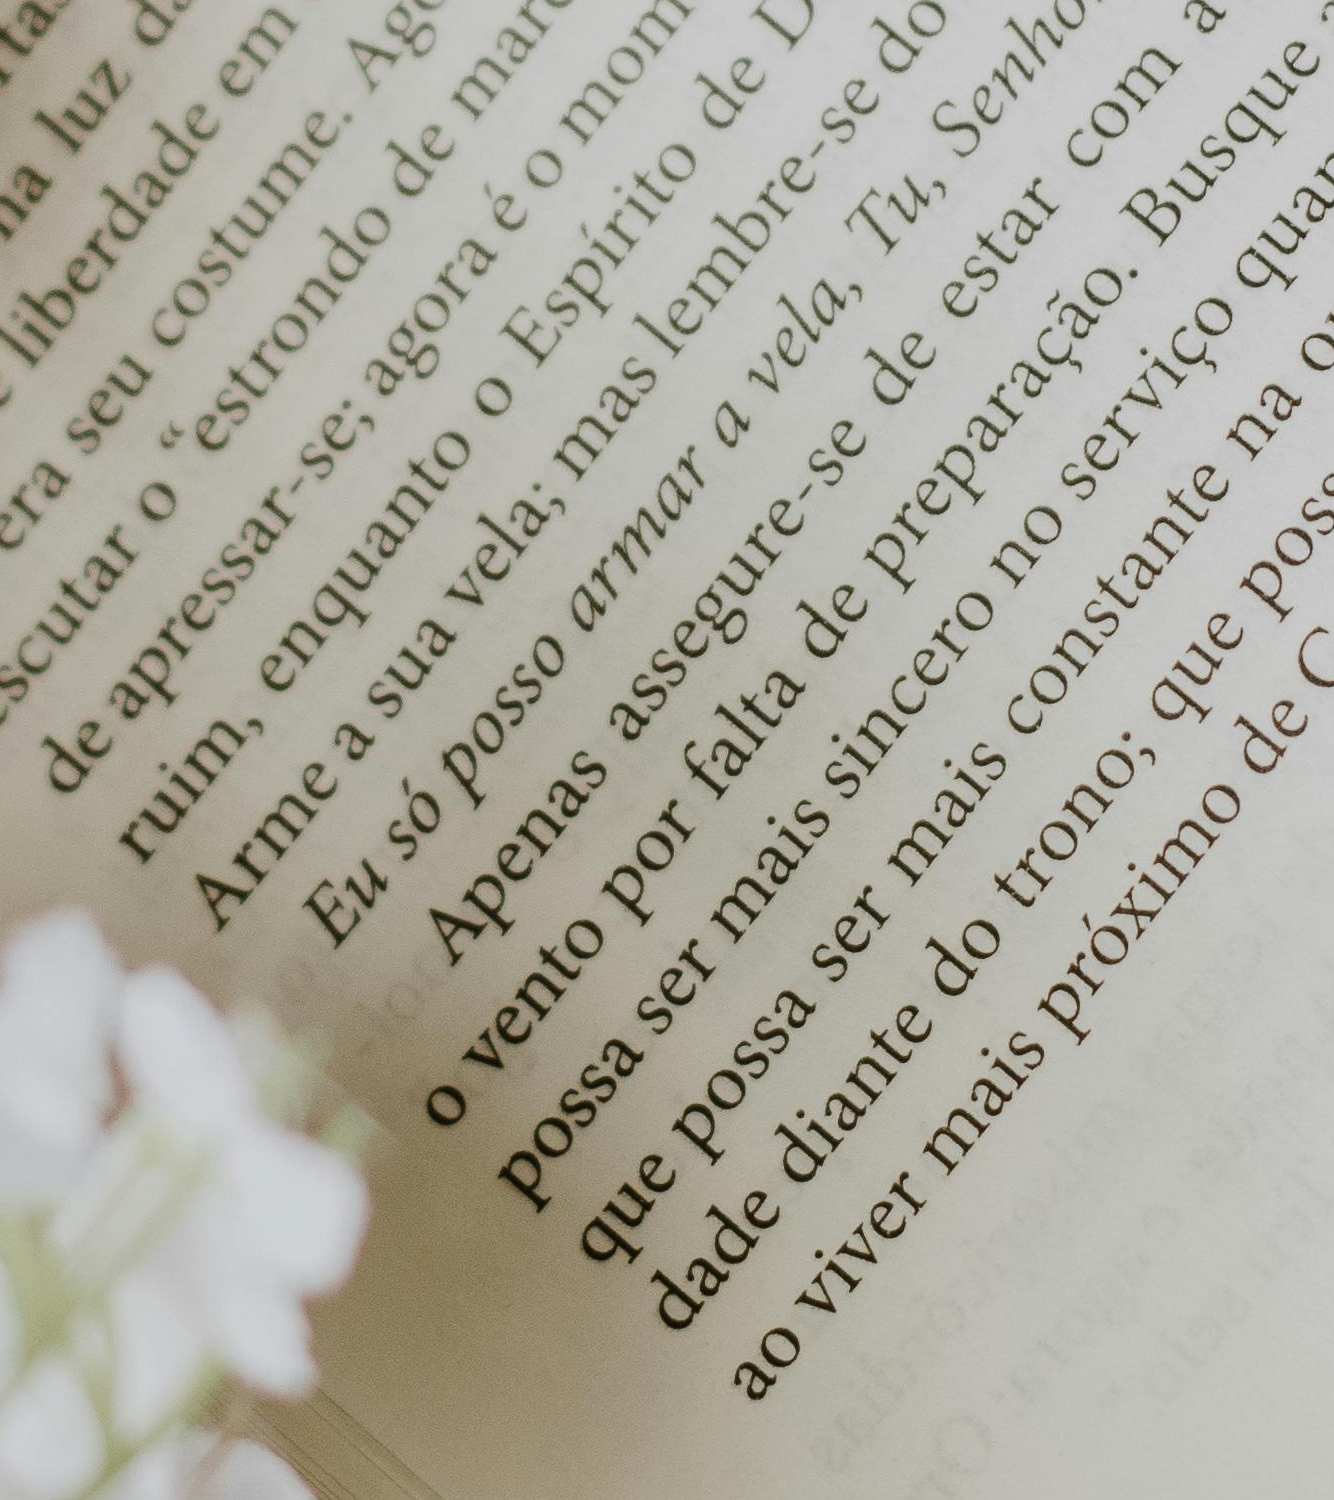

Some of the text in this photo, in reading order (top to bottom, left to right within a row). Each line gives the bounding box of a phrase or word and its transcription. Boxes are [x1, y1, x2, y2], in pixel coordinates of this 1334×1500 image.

[136, 480, 178, 524] o
[158, 205, 392, 454] “estrondo
[384, 123, 455, 199] de
[217, 5, 300, 99] em
[40, 719, 114, 795] de
[106, 398, 375, 721] apressar-se;
[363, 237, 499, 398] agora
[482, 181, 529, 233] é
[523, 147, 564, 190] o
[117, 717, 264, 866] ruim,
[259, 430, 471, 693] enquanto
[472, 375, 513, 418] o
[498, 142, 697, 369] Espírito
[693, 55, 766, 131] de
[193, 761, 338, 934] Arme
[332, 721, 376, 762] a
[366, 617, 458, 720] sua
[443, 481, 567, 607] vela;
[551, 355, 657, 483] mas
[631, 77, 880, 359] lembre-se
[300, 857, 389, 950] Eu
[386, 776, 442, 862] só
[440, 633, 565, 812] posso
[569, 444, 705, 634] armar
[713, 399, 751, 449] a
[746, 277, 864, 394] vela,
[842, 174, 947, 256] Tu,
[423, 1083, 468, 1128] o
[460, 918, 604, 1071] vento
[599, 797, 696, 927] por
[682, 669, 807, 802] falta
[794, 583, 869, 660] de
[862, 266, 1139, 595] preparação.
[1117, 39, 1321, 247] Busque
[428, 749, 608, 968] Apenas
[608, 418, 867, 742] assegure-se
[863, 331, 937, 406] de
[941, 175, 1060, 319] estar
[1066, 46, 1183, 168] com
[496, 1037, 645, 1215] possa
[635, 937, 716, 1036] ser
[709, 798, 831, 945] mais
[823, 590, 994, 800] sincero
[988, 504, 1063, 589] no
[1059, 296, 1234, 501] serviço
[579, 1153, 677, 1265] que
[670, 989, 817, 1167] possa
[810, 883, 890, 984] ser
[886, 741, 1007, 888] mais
[1006, 463, 1230, 735] constante
[1225, 382, 1303, 462] na
[649, 1189, 781, 1332] dade
[773, 1003, 933, 1184] diante
[924, 918, 1001, 997] do
[992, 730, 1157, 909] trono;
[1150, 611, 1245, 724] que
[732, 1326, 801, 1402] ao
[793, 1170, 927, 1314] viver
[921, 1030, 1045, 1176] mais
[1036, 783, 1241, 1046] próximo
[1232, 698, 1309, 775] de
